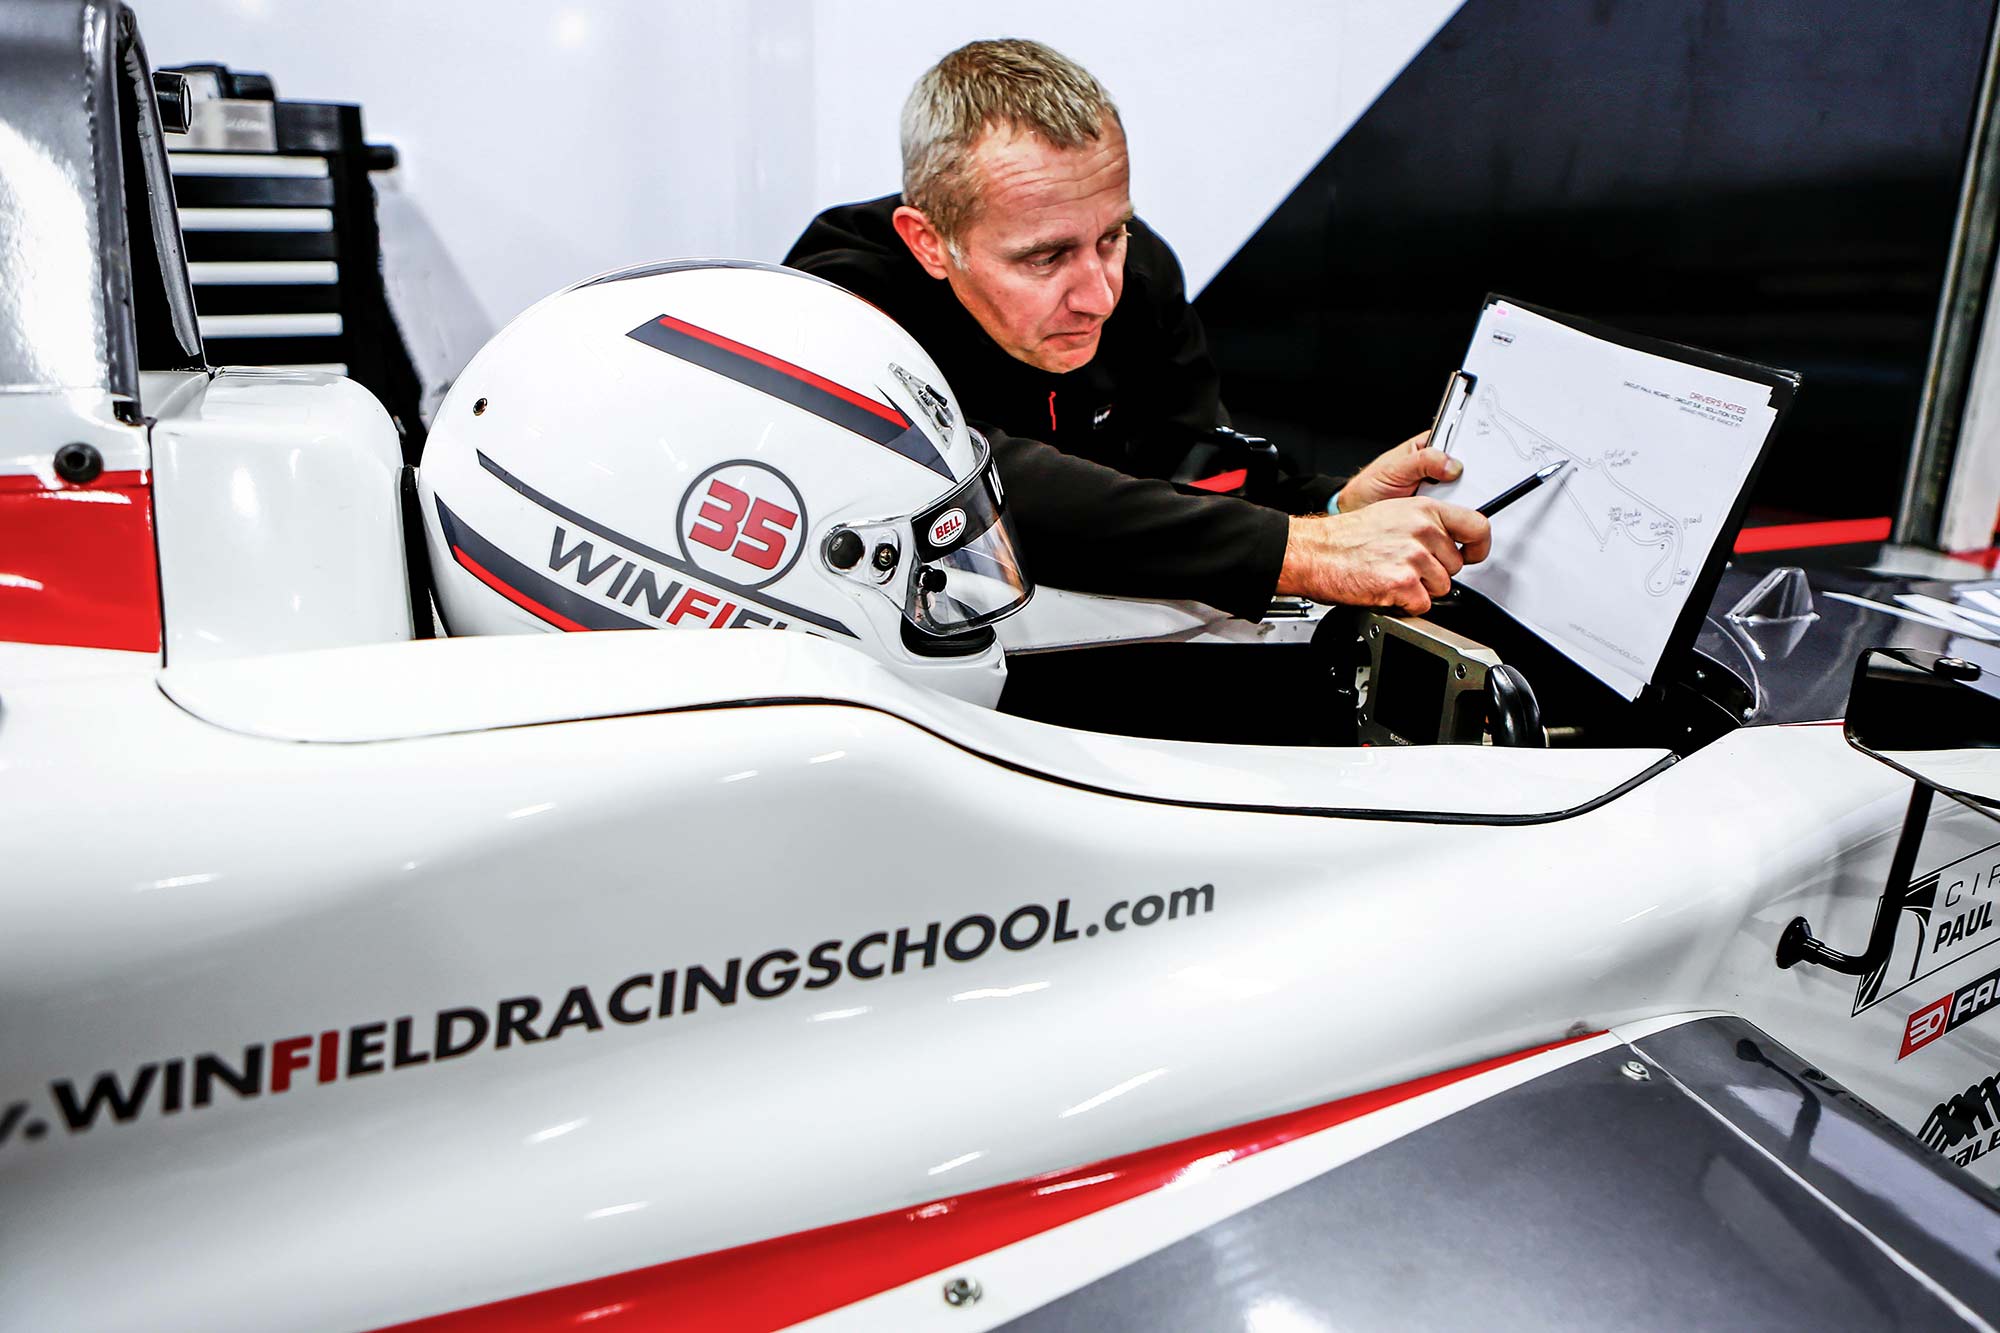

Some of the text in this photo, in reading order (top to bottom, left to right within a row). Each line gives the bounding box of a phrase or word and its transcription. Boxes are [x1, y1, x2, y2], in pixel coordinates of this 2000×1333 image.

[1723, 401, 1747, 415] NOTES
[689, 478, 798, 571] 35
[935, 515, 961, 539] BELL
[548, 525, 828, 639] WINFI
[1933, 900, 1993, 954] PAUL
